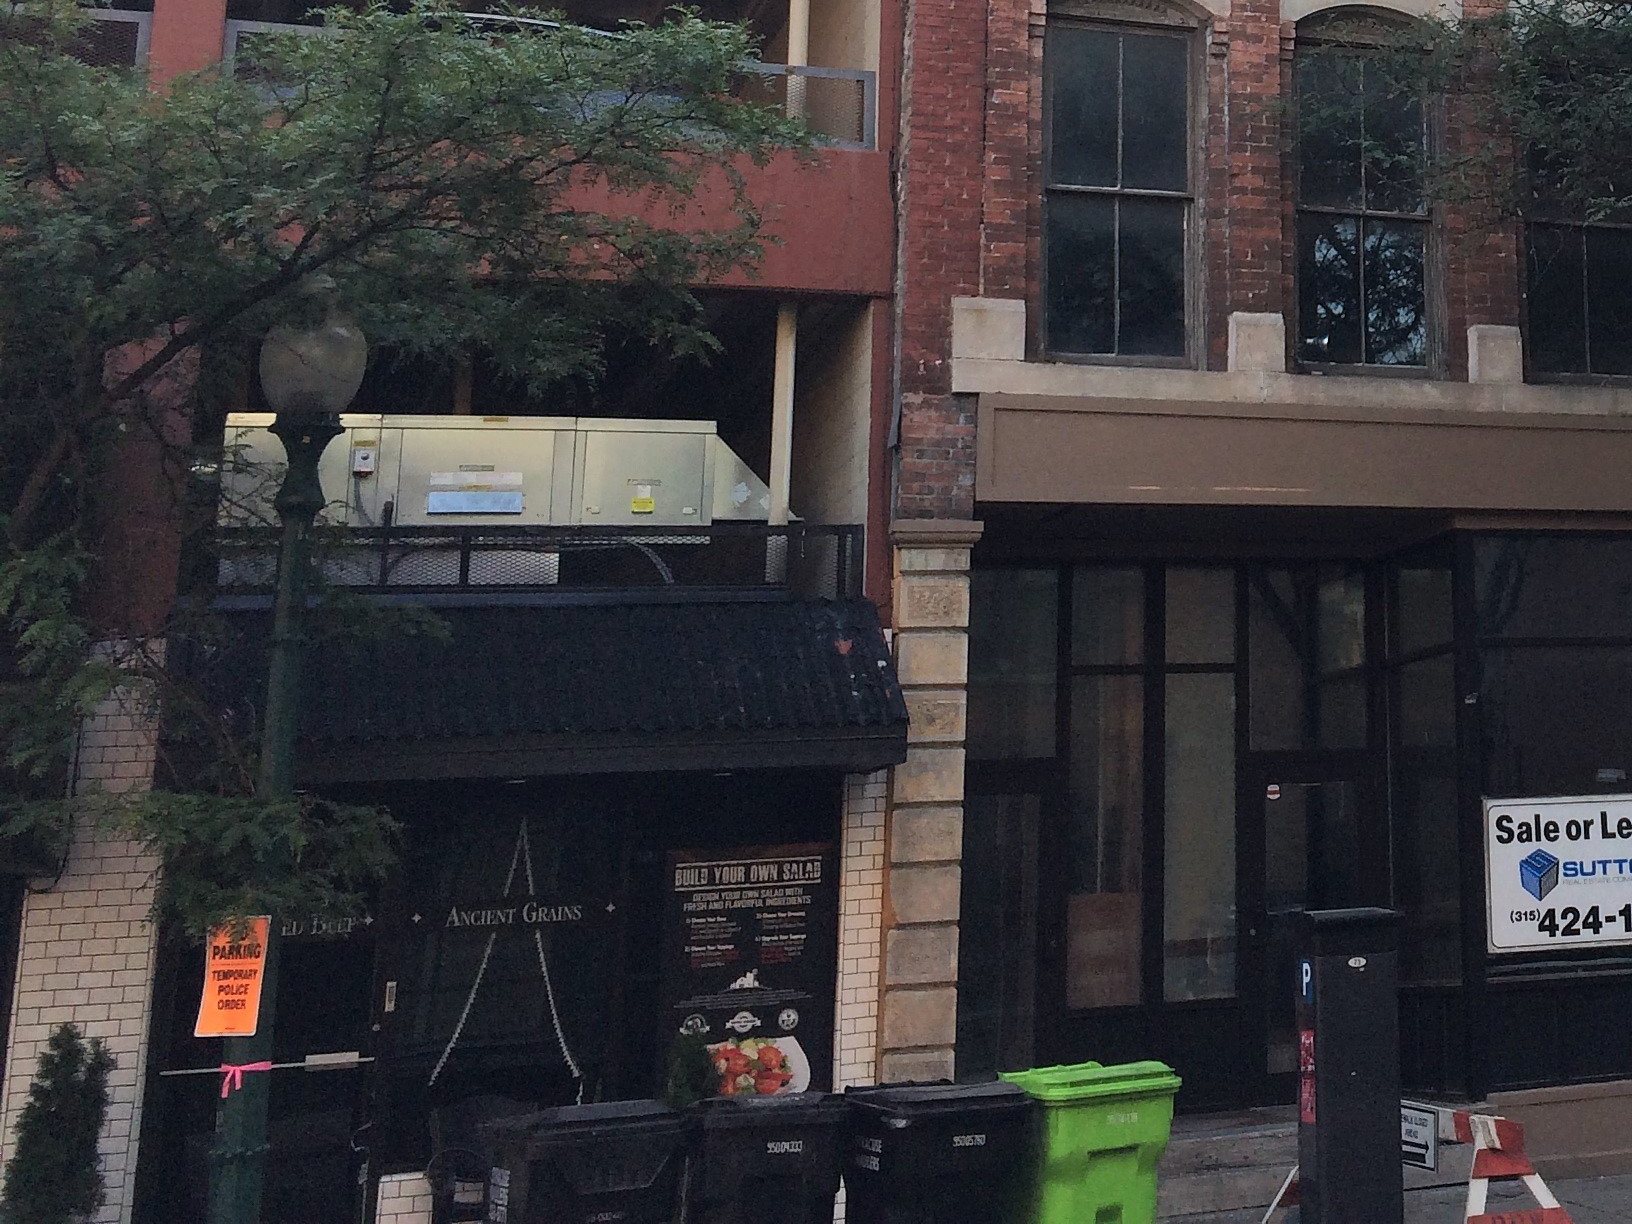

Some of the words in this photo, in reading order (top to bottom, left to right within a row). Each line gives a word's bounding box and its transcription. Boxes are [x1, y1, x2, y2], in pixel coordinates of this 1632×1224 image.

[1495, 813, 1560, 844] Sale
[1565, 818, 1595, 841] or
[675, 868, 709, 886] BUILD
[714, 866, 746, 884] YOUR
[750, 864, 778, 882] OWN
[782, 861, 821, 881] SALAD
[721, 891, 742, 901] YOUR
[742, 889, 760, 899] OWN
[760, 888, 784, 898] SALAD
[785, 887, 804, 896] WITH
[683, 901, 708, 912] FRESH
[708, 900, 724, 910] AND
[765, 895, 812, 907] INGREDIENTS
[1510, 908, 1541, 924] (315)
[211, 943, 262, 960] PARKING
[212, 968, 259, 981] TEMPORARY
[1302, 962, 1312, 996] P
[217, 983, 250, 996] POLICE
[217, 998, 247, 1010] ORDER
